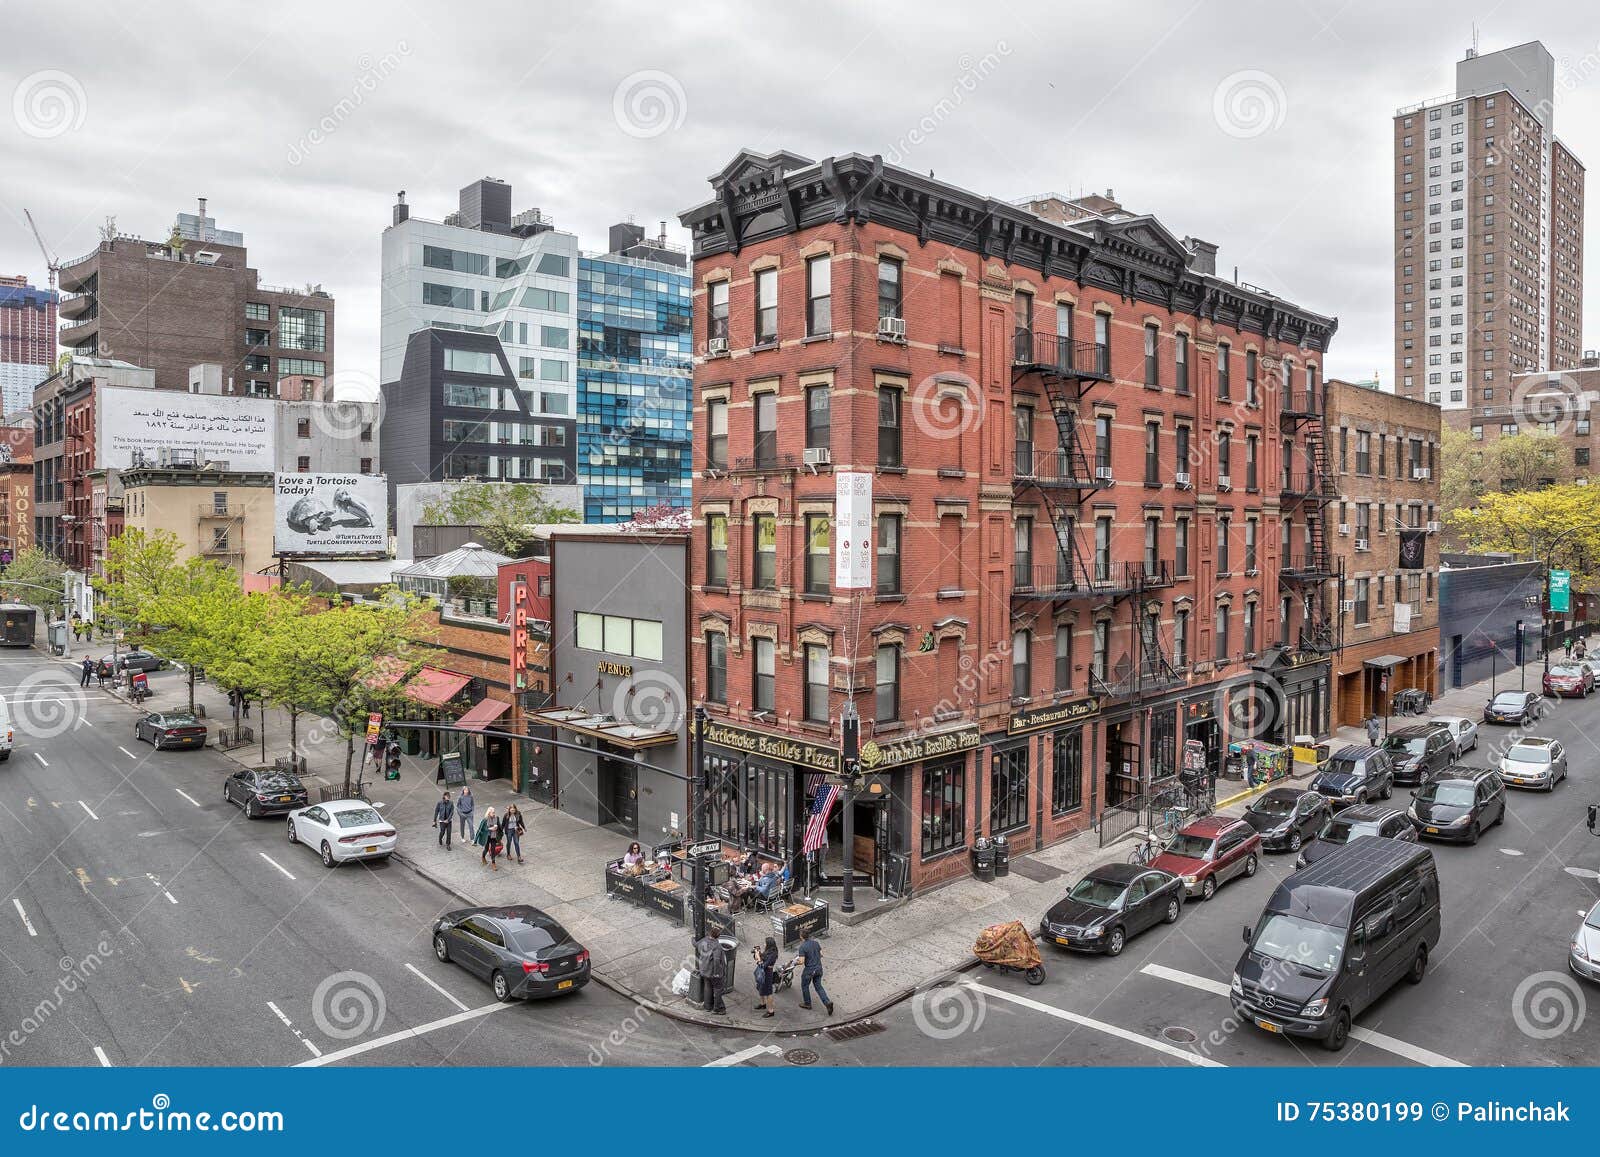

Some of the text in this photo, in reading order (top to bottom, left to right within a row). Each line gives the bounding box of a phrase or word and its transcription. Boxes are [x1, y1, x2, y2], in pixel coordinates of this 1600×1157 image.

[278, 476, 304, 484] Love
[316, 476, 358, 485] Tortoise
[278, 486, 314, 496] Today!
[598, 661, 632, 678] AVENUE
[1013, 718, 1027, 728] Bar
[1031, 708, 1068, 725] Restaurant
[708, 725, 756, 750] Artichoke
[804, 746, 837, 768] Pizza
